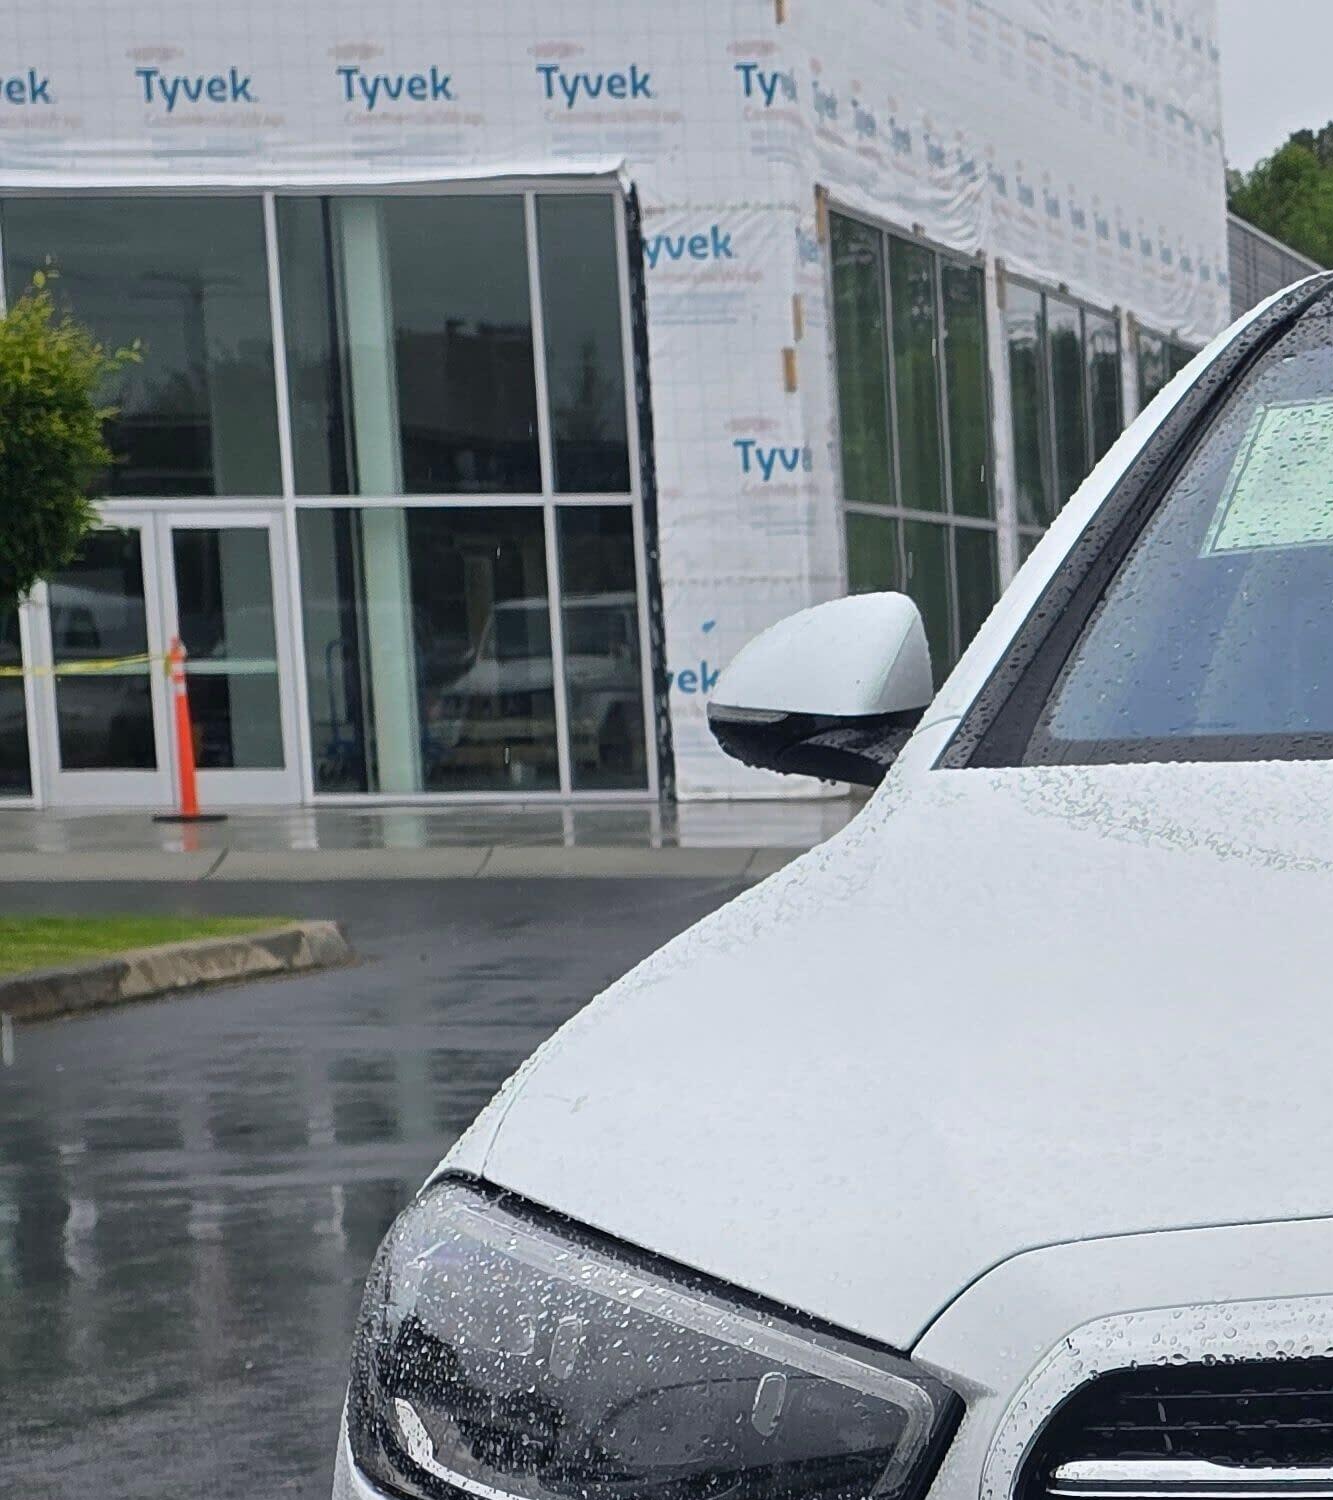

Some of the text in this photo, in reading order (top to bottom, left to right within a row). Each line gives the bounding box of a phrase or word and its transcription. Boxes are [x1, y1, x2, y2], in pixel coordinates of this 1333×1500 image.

[0, 67, 52, 104] ek
[135, 66, 253, 112] Tyvek
[336, 65, 455, 111] Tyvek
[536, 63, 655, 109] Tyvek
[641, 224, 734, 269] yvek
